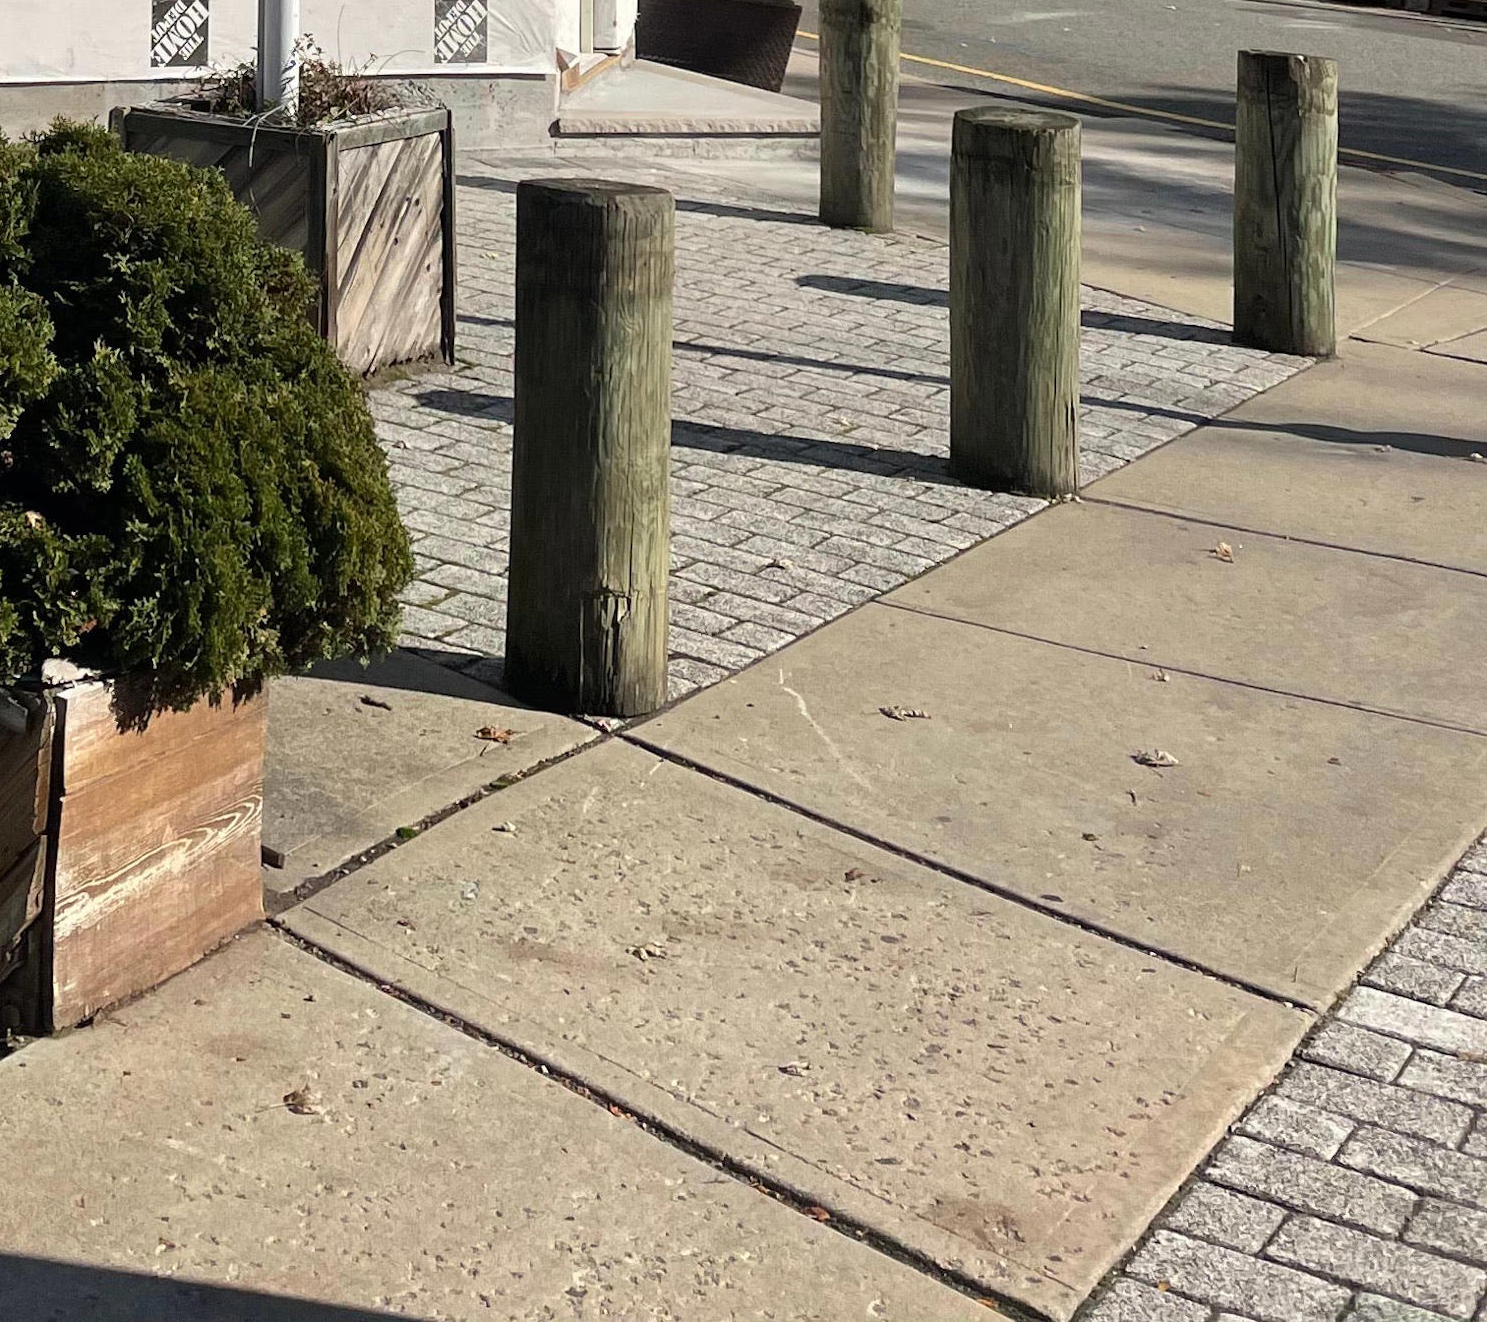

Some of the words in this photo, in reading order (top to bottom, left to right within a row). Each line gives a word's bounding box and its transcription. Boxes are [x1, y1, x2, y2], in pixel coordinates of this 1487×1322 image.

[150, 0, 209, 67] HOME
[151, 0, 187, 43] DEPOT
[433, 0, 488, 63] HOME
[434, 0, 467, 40] DEPOT
[178, 33, 205, 60] THE
